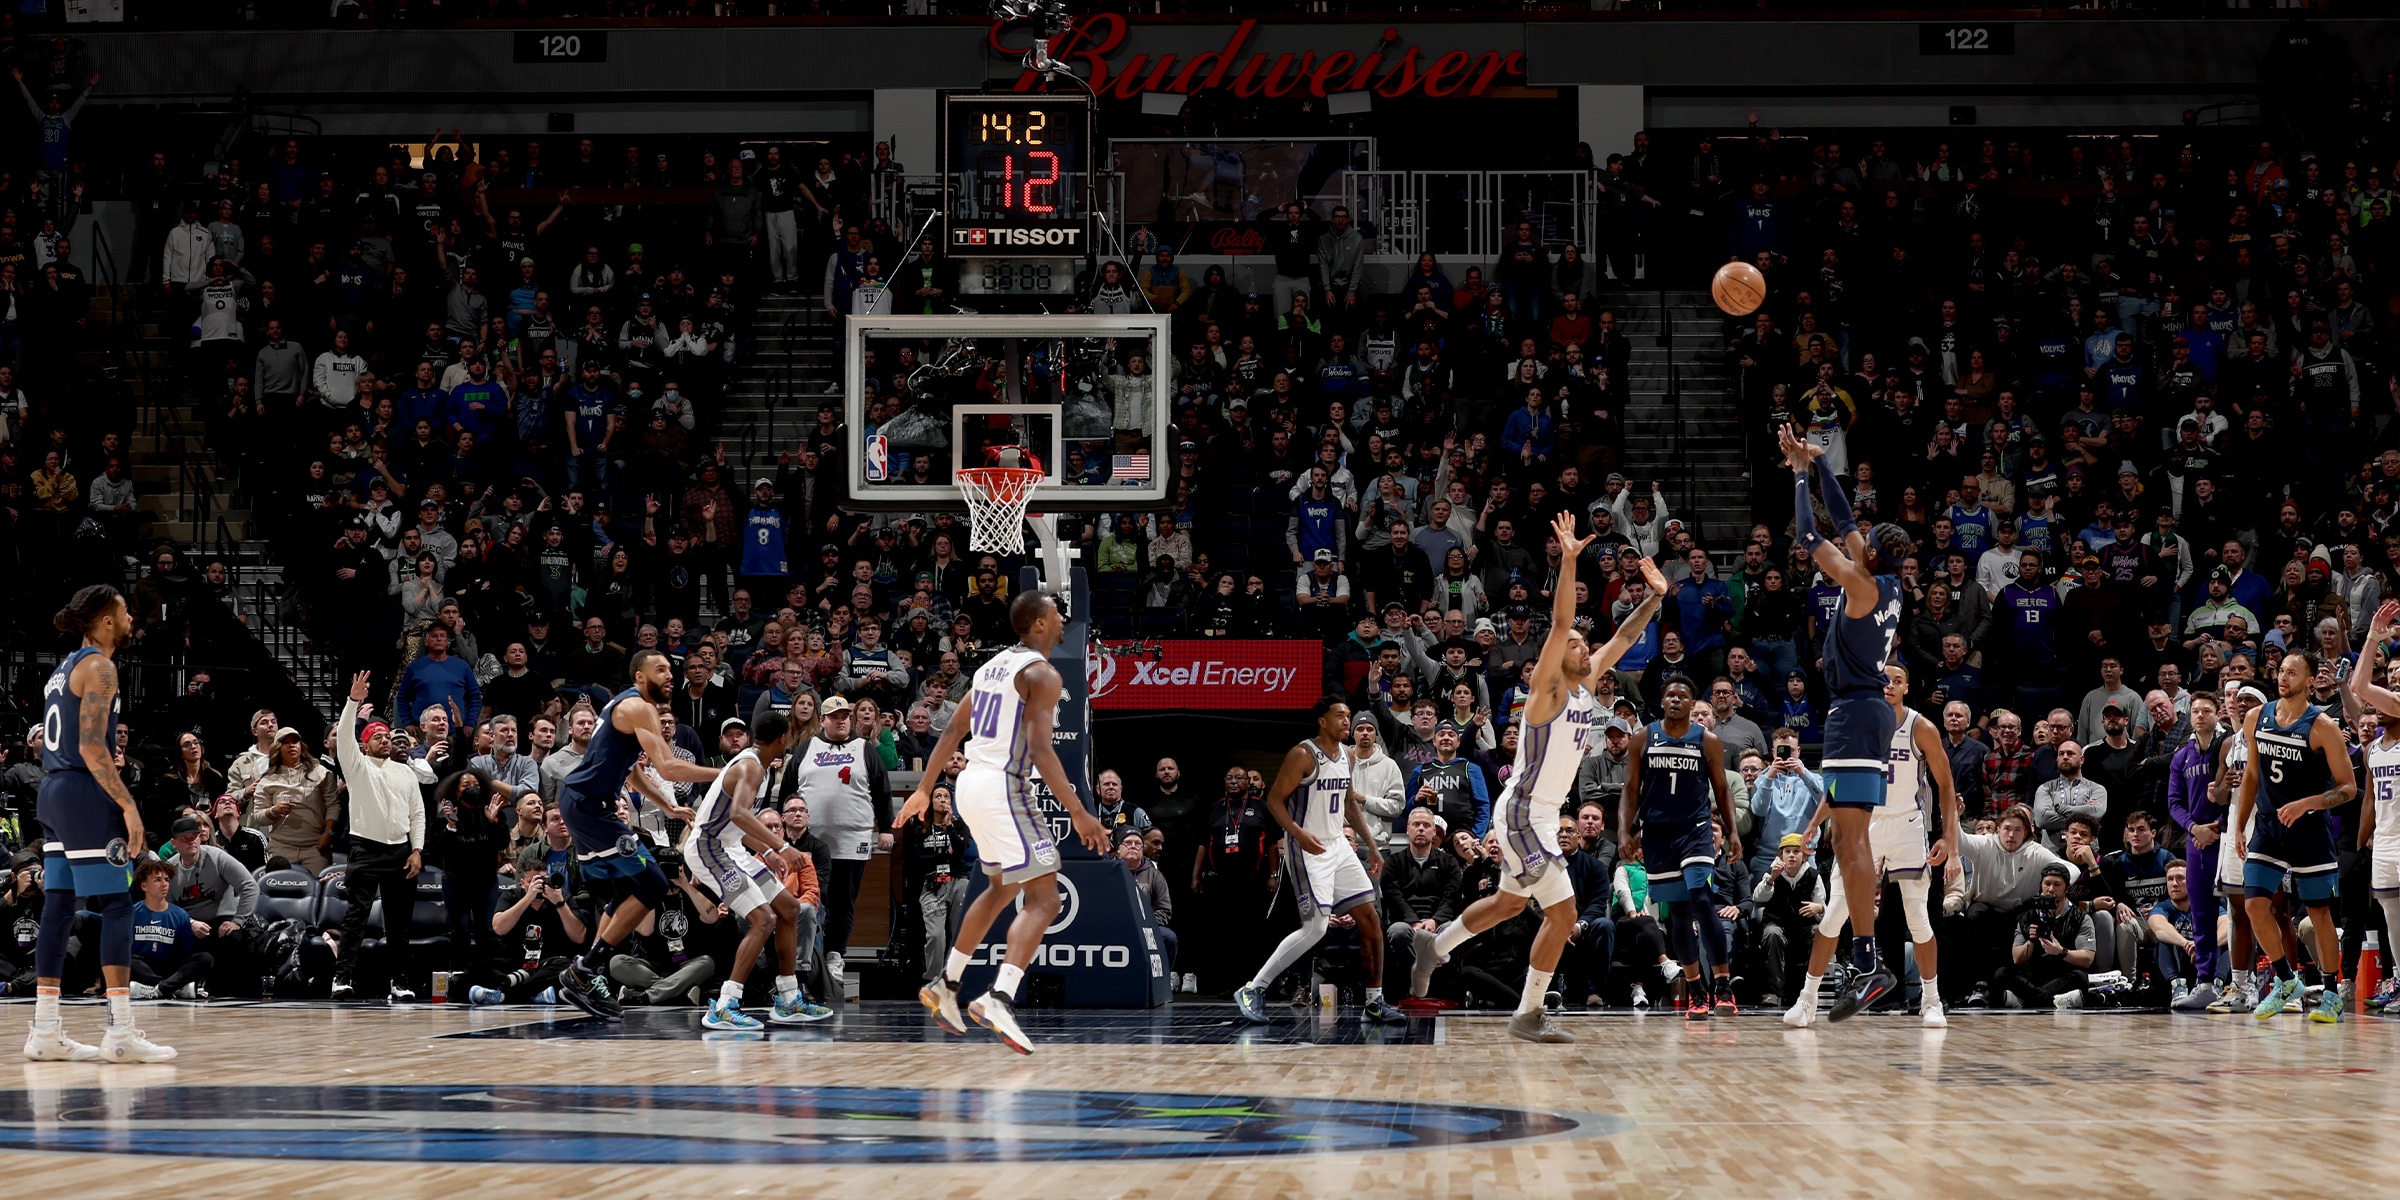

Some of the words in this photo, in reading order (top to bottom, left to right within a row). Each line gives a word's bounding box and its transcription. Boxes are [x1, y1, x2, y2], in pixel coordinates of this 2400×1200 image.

[1945, 28, 1989, 49] 122
[539, 35, 581, 57] 120
[988, 12, 1526, 99] Budweiser
[981, 110, 1046, 144] 14.2
[44, 129, 60, 142] 21
[1004, 150, 1059, 213] 12
[988, 229, 1080, 245] TISSOT
[1211, 227, 1268, 253] Bally
[502, 241, 525, 251] WOLVES
[509, 252, 515, 261] 9
[215, 300, 225, 310] 0
[864, 293, 875, 304] 11
[2210, 320, 2233, 331] WOLVES
[1241, 371, 1257, 380] 32
[2111, 373, 2136, 385] WOLVES
[2314, 374, 2333, 387] 32
[579, 404, 602, 417] WOLVES
[1822, 436, 1829, 446] 5
[1307, 506, 1329, 517] WOLVES
[1957, 523, 1985, 534] WOLVES
[757, 528, 770, 546] 8
[1962, 536, 1977, 548] 21
[551, 565, 560, 578] 3
[2116, 567, 2133, 581] 25
[2017, 598, 2047, 607] SAC
[2025, 610, 2039, 623] 13
[1876, 628, 1896, 672] 3
[1129, 661, 1200, 685] Xcel
[1202, 661, 1297, 692] Energy
[970, 690, 1002, 739] 40
[44, 703, 62, 752] 0
[2256, 740, 2303, 762] MINNESOTA
[813, 751, 855, 767] Kings
[1648, 756, 1699, 771] MINNESOTA
[838, 766, 851, 785] 4
[2269, 760, 2284, 784] 5
[1316, 778, 1350, 791] KINGS
[1423, 776, 1460, 790] MINN
[1669, 772, 1678, 795] 1
[2377, 780, 2393, 801] 15
[1329, 793, 1340, 814] 0
[134, 925, 176, 938] TIMBERWOLVES
